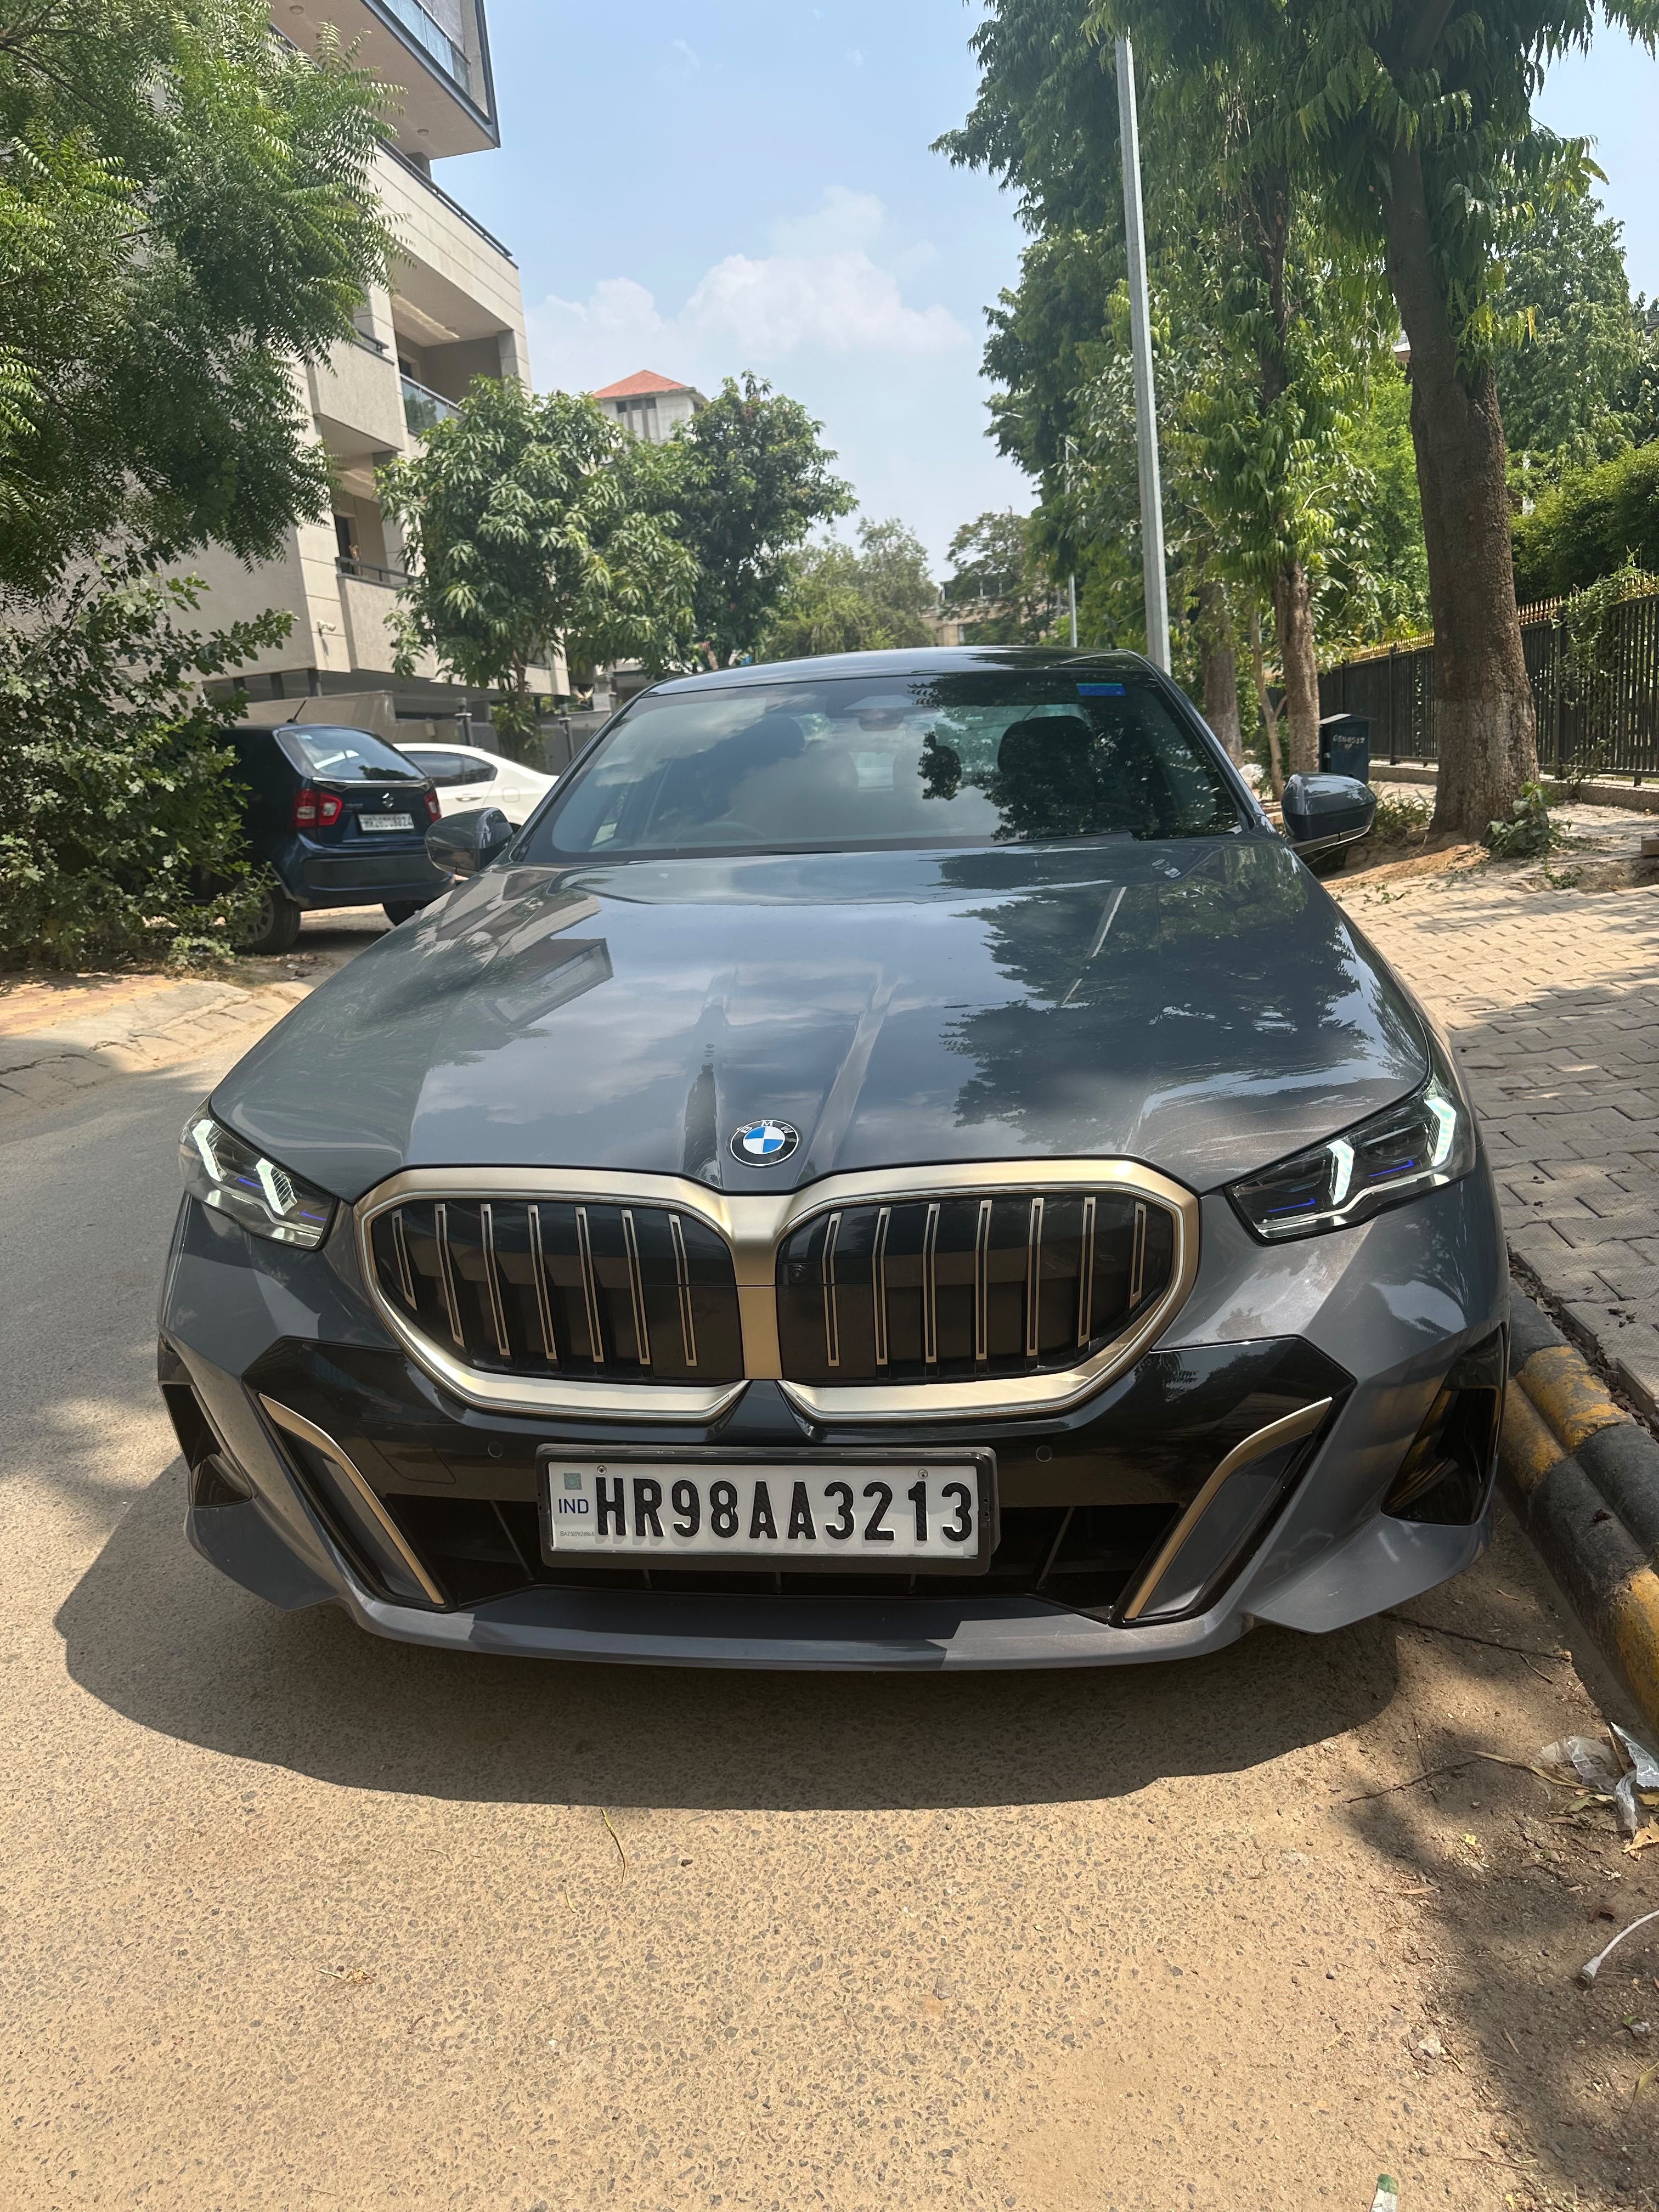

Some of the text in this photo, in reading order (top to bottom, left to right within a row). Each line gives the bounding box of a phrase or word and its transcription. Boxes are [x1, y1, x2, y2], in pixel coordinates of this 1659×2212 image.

[740, 1121, 794, 1133] BMW
[558, 1498, 589, 1514] IND
[596, 1477, 972, 1542] HR98AA3213
